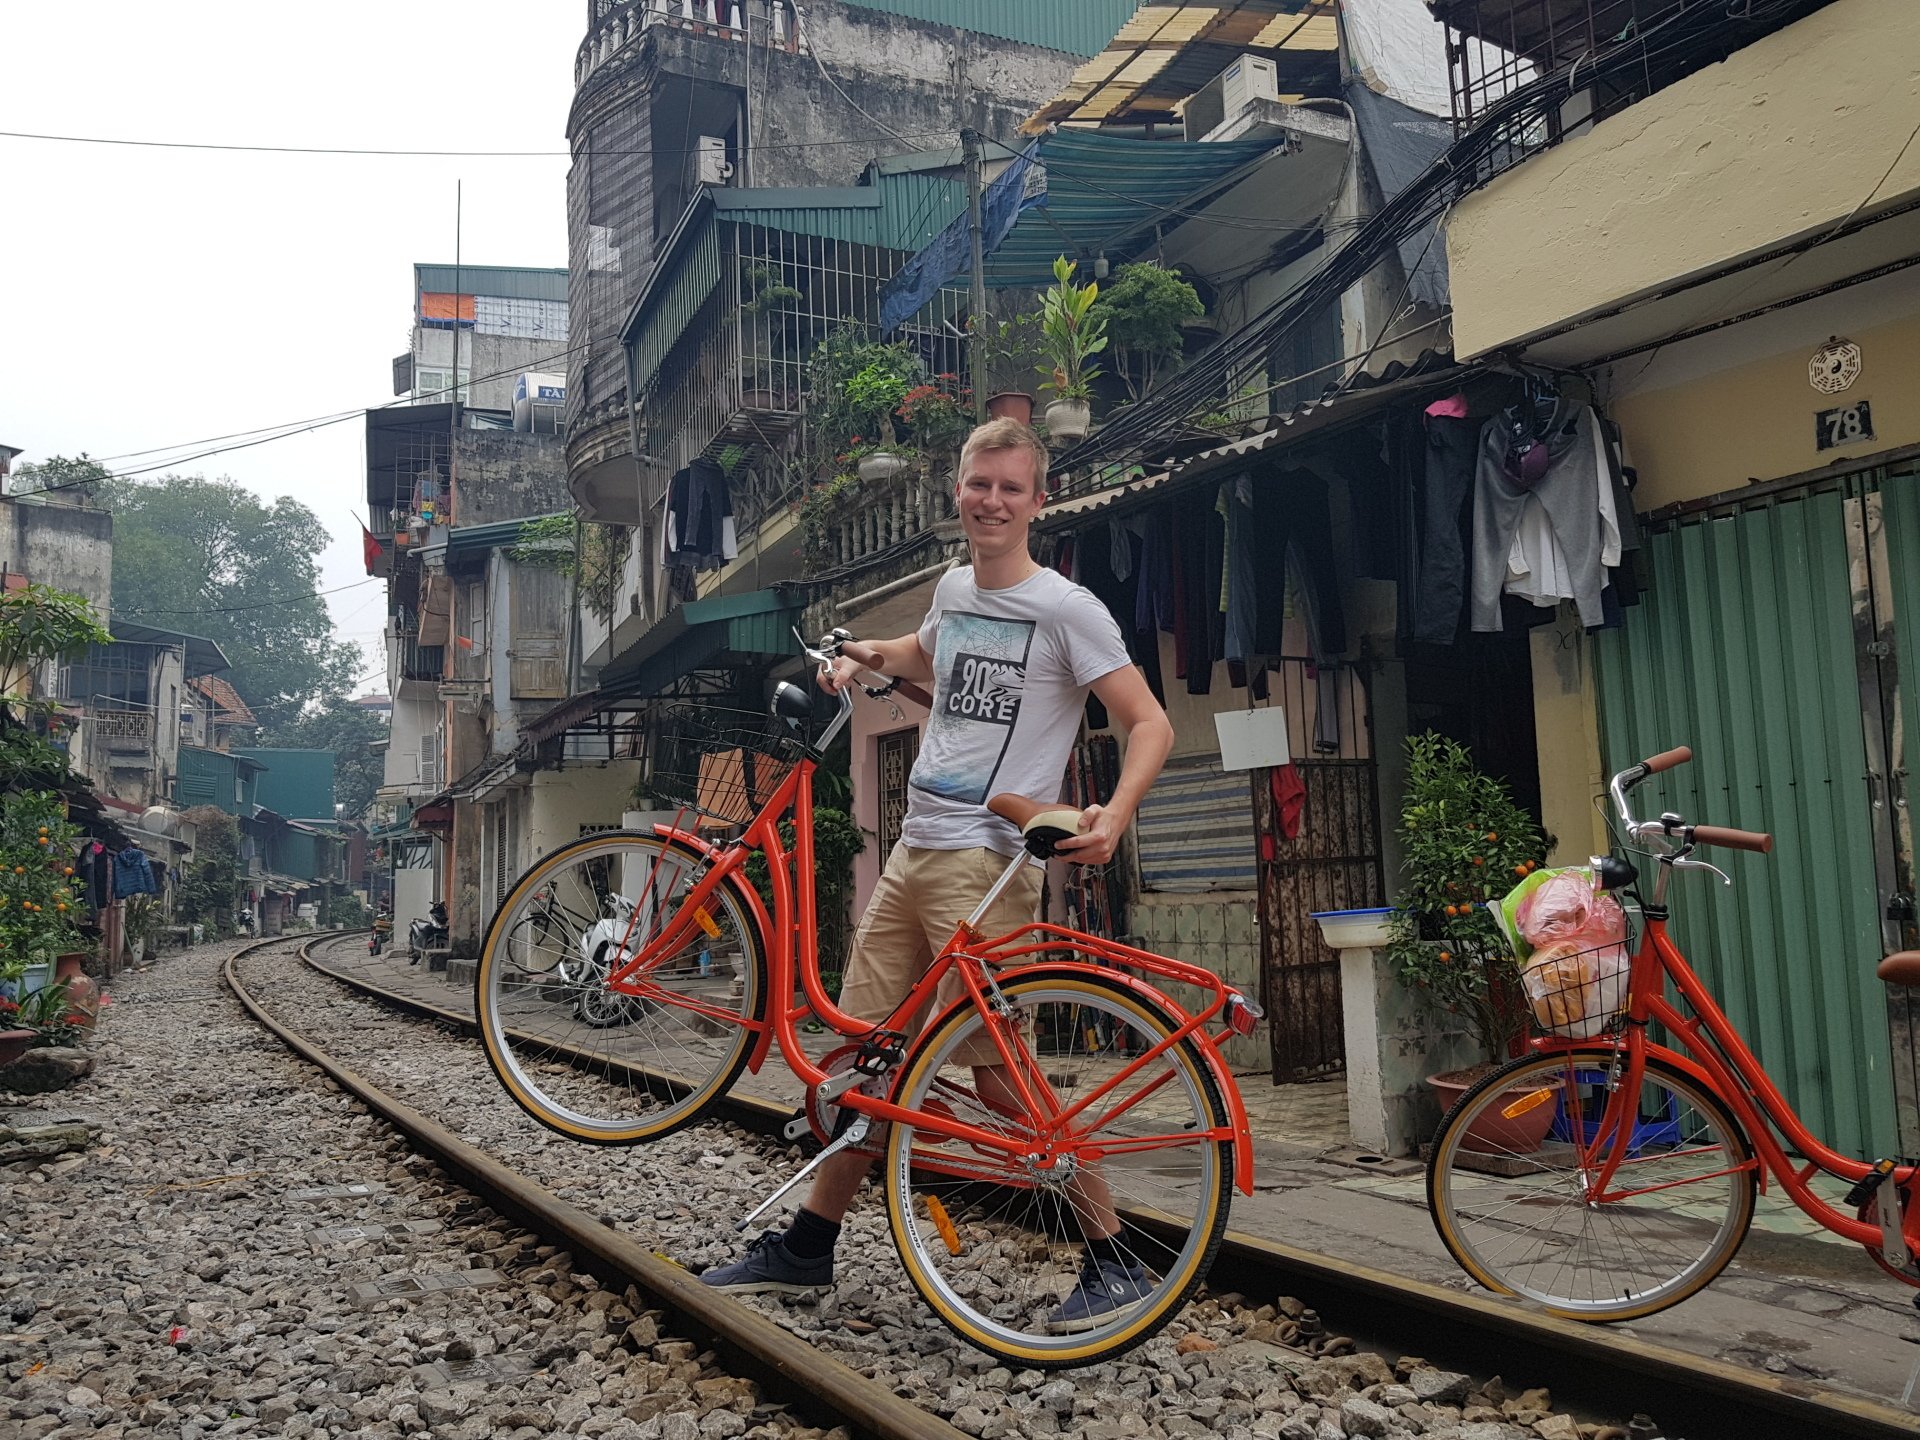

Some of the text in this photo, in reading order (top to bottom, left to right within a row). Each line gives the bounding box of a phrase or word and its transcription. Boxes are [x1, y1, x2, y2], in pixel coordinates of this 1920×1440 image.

[1825, 409, 1862, 446] 78
[949, 692, 1016, 721] CORE
[901, 1185, 909, 1209] WALL
